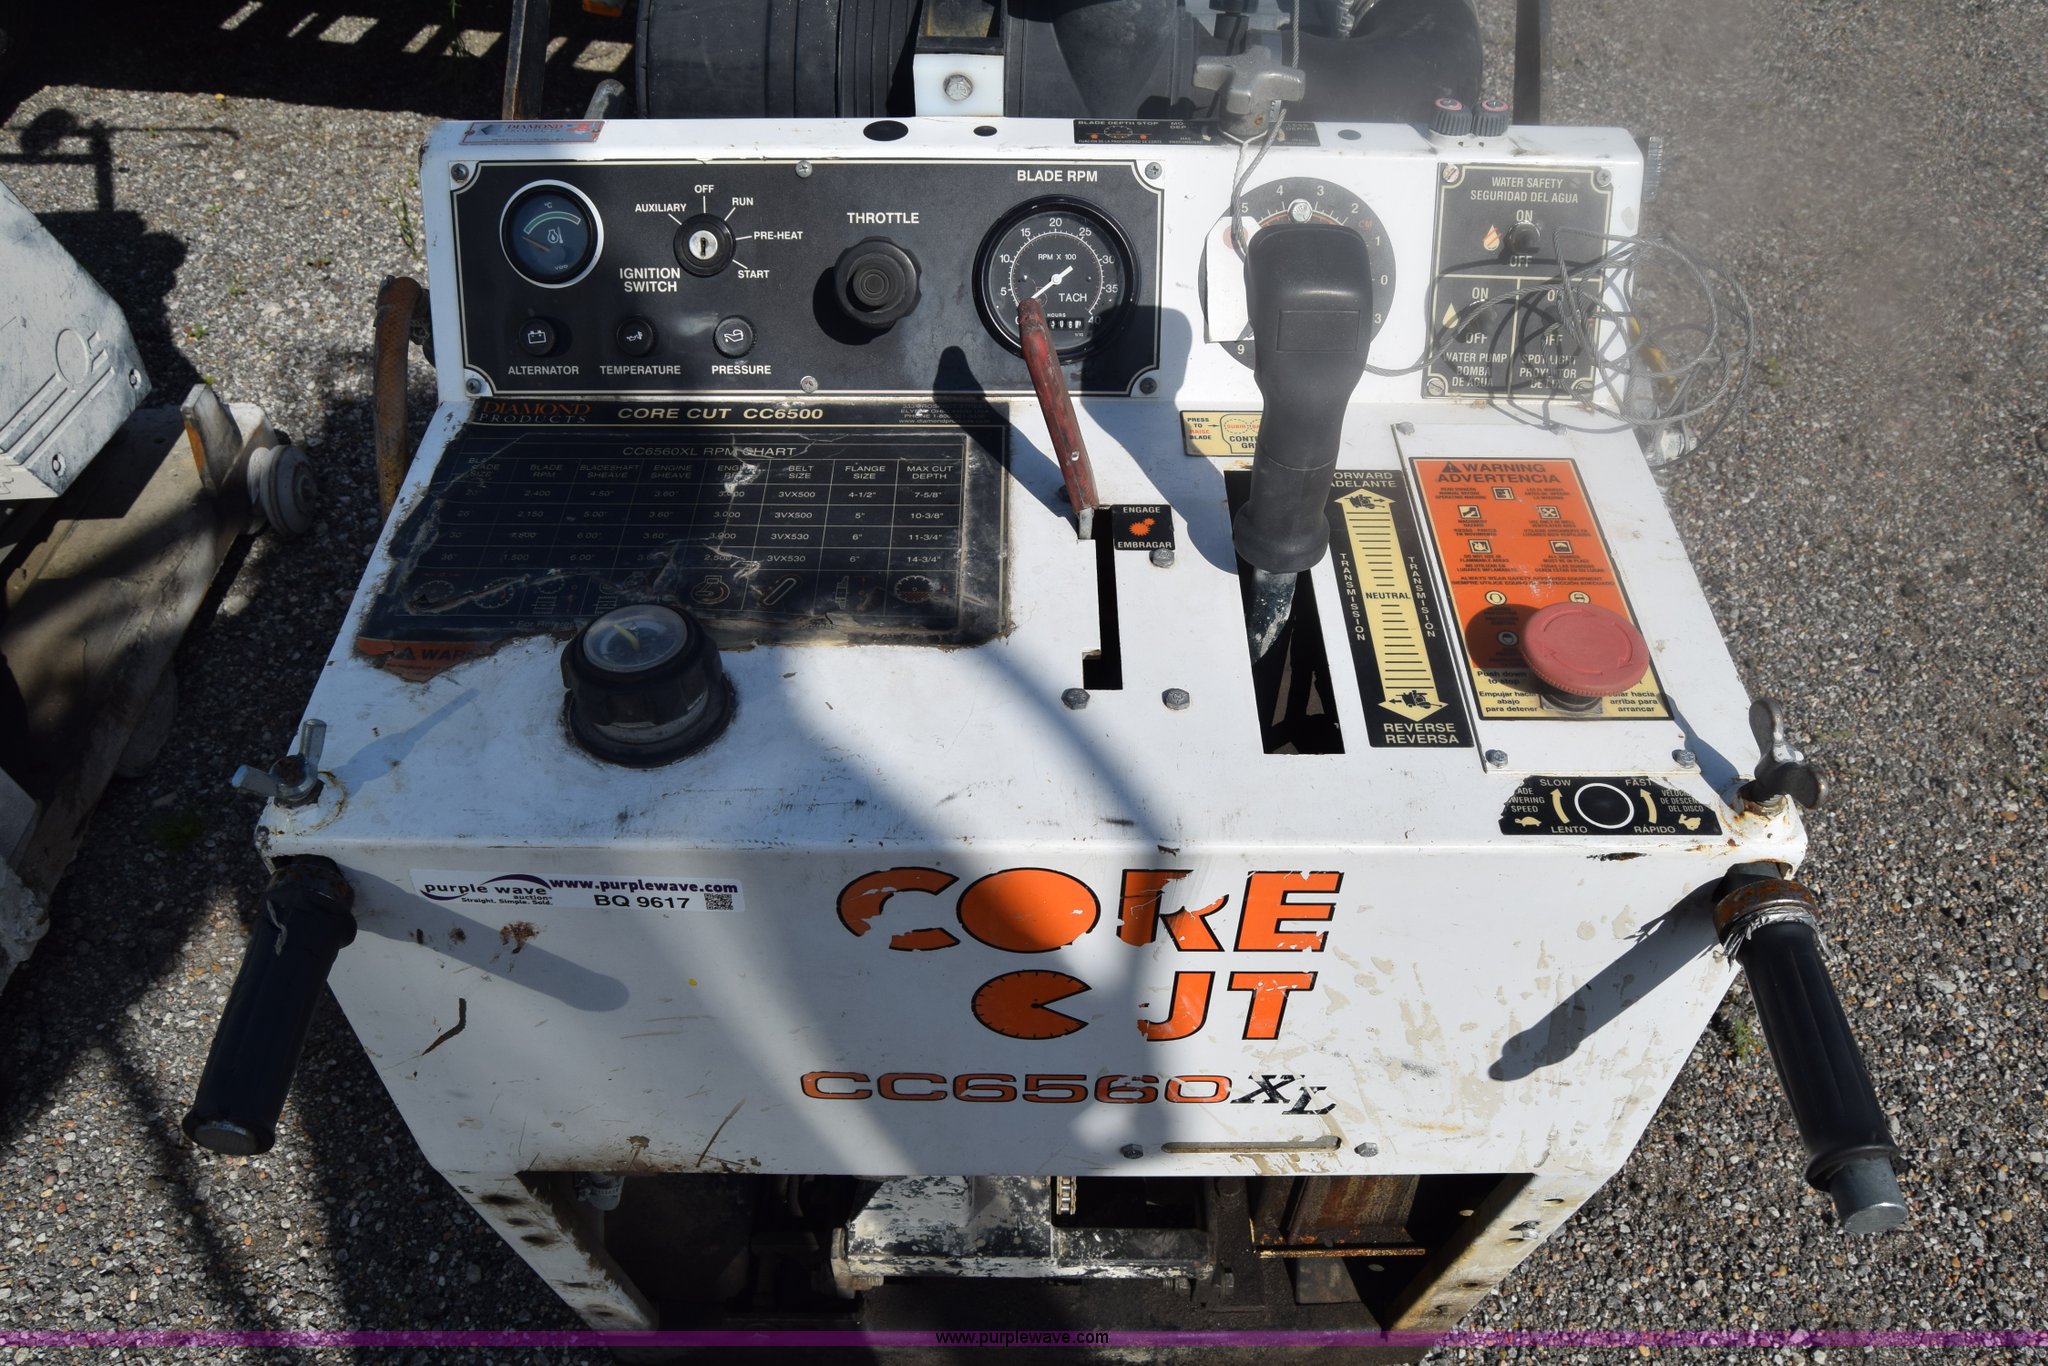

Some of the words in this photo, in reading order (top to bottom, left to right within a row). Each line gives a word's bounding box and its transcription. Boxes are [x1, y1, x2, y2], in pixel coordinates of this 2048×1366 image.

[1017, 170, 1063, 182] BLADE
[1067, 170, 1098, 182] RPM
[1492, 177, 1523, 188] WATER
[1526, 178, 1563, 188] SAFETY
[694, 185, 714, 193] OFF
[1276, 185, 1283, 195] 4
[1317, 185, 1324, 196] 3
[732, 197, 754, 206] RUN
[1470, 190, 1527, 202] SEGURIDAD
[1531, 192, 1548, 202] DEL
[1552, 193, 1578, 203] AGUA
[635, 203, 686, 212] AUXILIARY
[1241, 203, 1248, 213] 5
[1352, 203, 1359, 213] 2
[847, 212, 920, 224] THROTTLE
[1516, 210, 1533, 222] ON
[1050, 218, 1062, 226] 20
[754, 231, 804, 240] PRE-HEAT
[1021, 228, 1031, 236] 15
[1079, 228, 1092, 236] 25
[1000, 254, 1010, 262] 10
[1102, 255, 1114, 264] 30
[1509, 256, 1533, 267] OFF
[620, 268, 680, 279] IGNITION
[738, 270, 770, 278] START
[1380, 275, 1388, 285] 0
[624, 281, 677, 292] SWITCH
[1000, 287, 1007, 296] 5
[1106, 285, 1118, 293] 35
[1058, 293, 1087, 302] TACH
[1472, 287, 1489, 299] ON
[1466, 332, 1488, 344] OFF
[1237, 344, 1245, 354] 9
[1479, 353, 1507, 363] PUMP
[508, 366, 579, 375] ALTERNATOR
[600, 366, 681, 375] TEMPERATURE
[712, 365, 772, 375] PRESSURE
[1456, 366, 1491, 376] BOMBA
[1452, 377, 1464, 386] DE
[1466, 377, 1494, 387] AGUA
[482, 400, 591, 415] DIAMOND
[480, 413, 586, 423] PRODUCTS
[618, 408, 679, 419] CORE
[686, 408, 732, 419] CUT
[743, 408, 824, 420] CC6500
[622, 447, 698, 456] CC6560XL
[703, 447, 737, 456] RPM
[743, 447, 796, 456] CHART
[1462, 464, 1546, 473] WARNING
[1437, 474, 1560, 483] ADVERTENCIA
[1340, 553, 1365, 640] TRANSMISSION
[1383, 723, 1456, 732] REVERSE
[1385, 734, 1459, 744] REVERSA
[424, 884, 488, 894] purple
[494, 886, 547, 895] wave
[549, 879, 738, 893] www.purplewave.com
[594, 895, 630, 907] BQ
[636, 896, 690, 909] 9617
